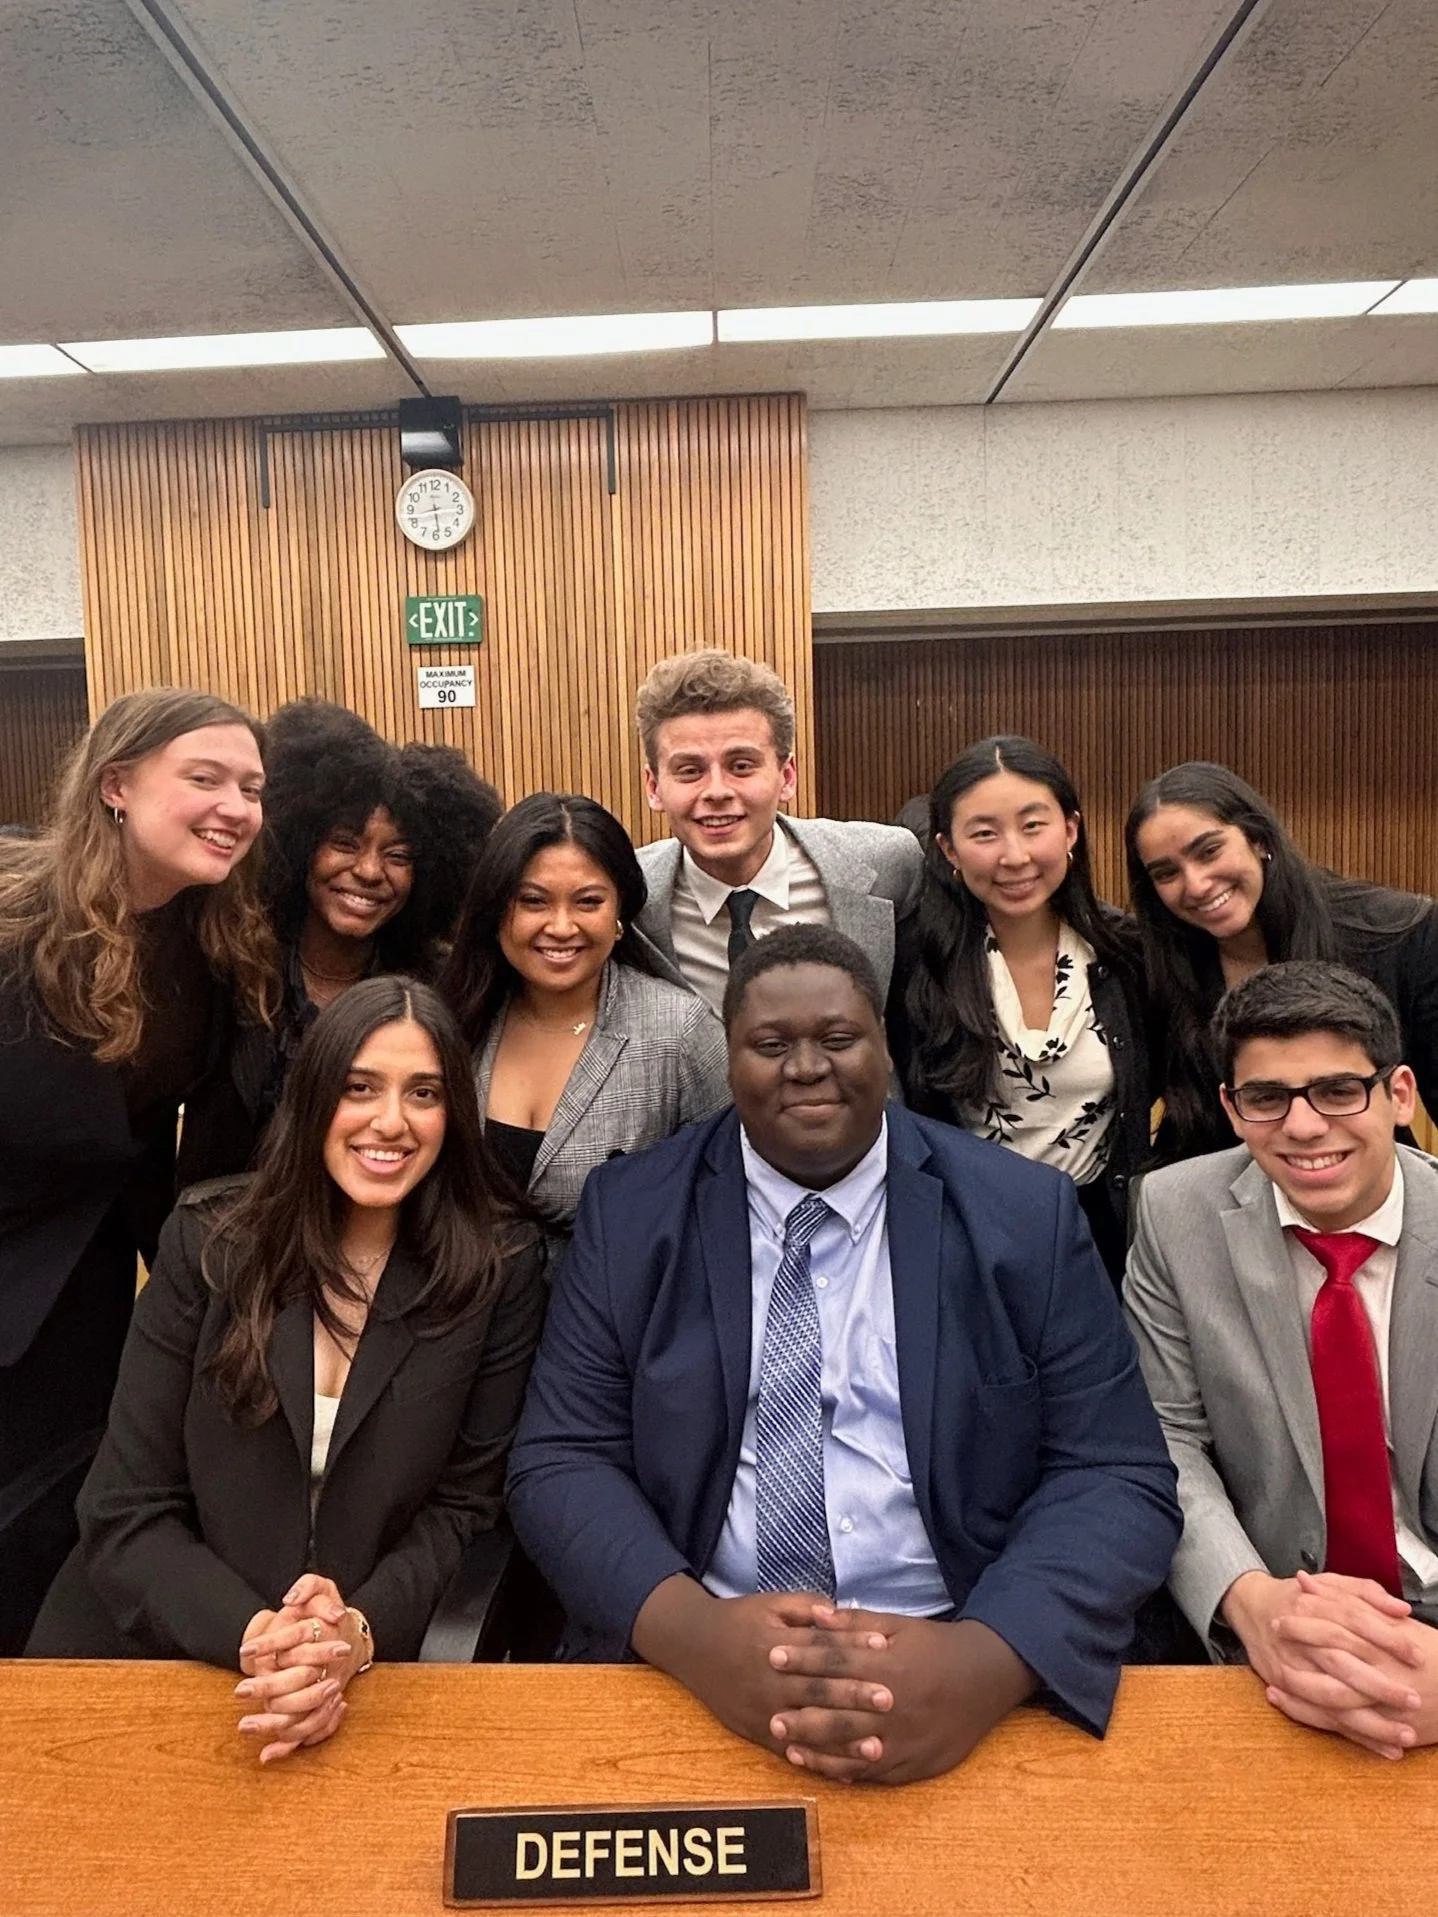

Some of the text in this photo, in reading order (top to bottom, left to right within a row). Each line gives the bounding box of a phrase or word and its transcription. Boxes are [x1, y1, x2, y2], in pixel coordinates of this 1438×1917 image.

[419, 483, 427, 493] 11
[429, 480, 441, 491] 12
[409, 492, 420, 503] 10
[452, 492, 460, 503] 2
[407, 505, 414, 515] 9
[456, 504, 464, 515] 3
[421, 527, 427, 537] 7
[432, 530, 440, 541] 6
[444, 527, 452, 537] 5
[419, 601, 467, 638] EXIT
[425, 670, 466, 678] MAXIMUM
[420, 680, 472, 688] OCCUPANCY
[437, 690, 456, 703] 90
[515, 1827, 747, 1880] DEFENSE
